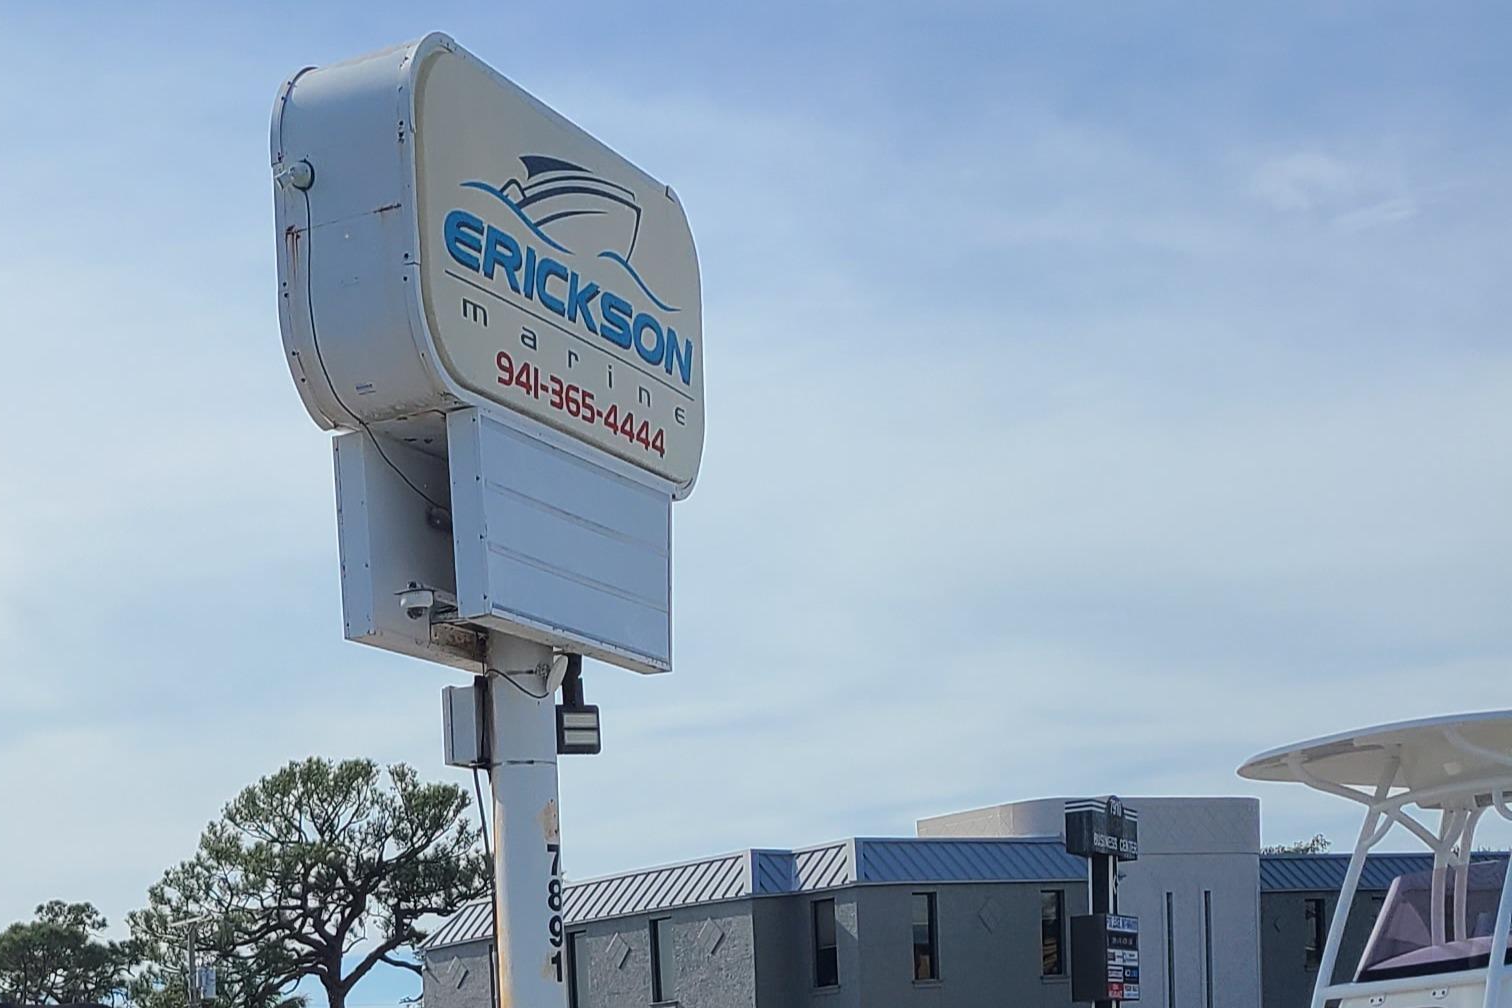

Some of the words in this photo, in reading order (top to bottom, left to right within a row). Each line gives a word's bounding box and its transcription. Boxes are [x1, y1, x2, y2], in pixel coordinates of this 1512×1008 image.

[443, 209, 694, 386] ERICKSON
[461, 297, 687, 426] marine
[495, 350, 666, 459] 941-365-4444
[546, 843, 564, 983] 7891
